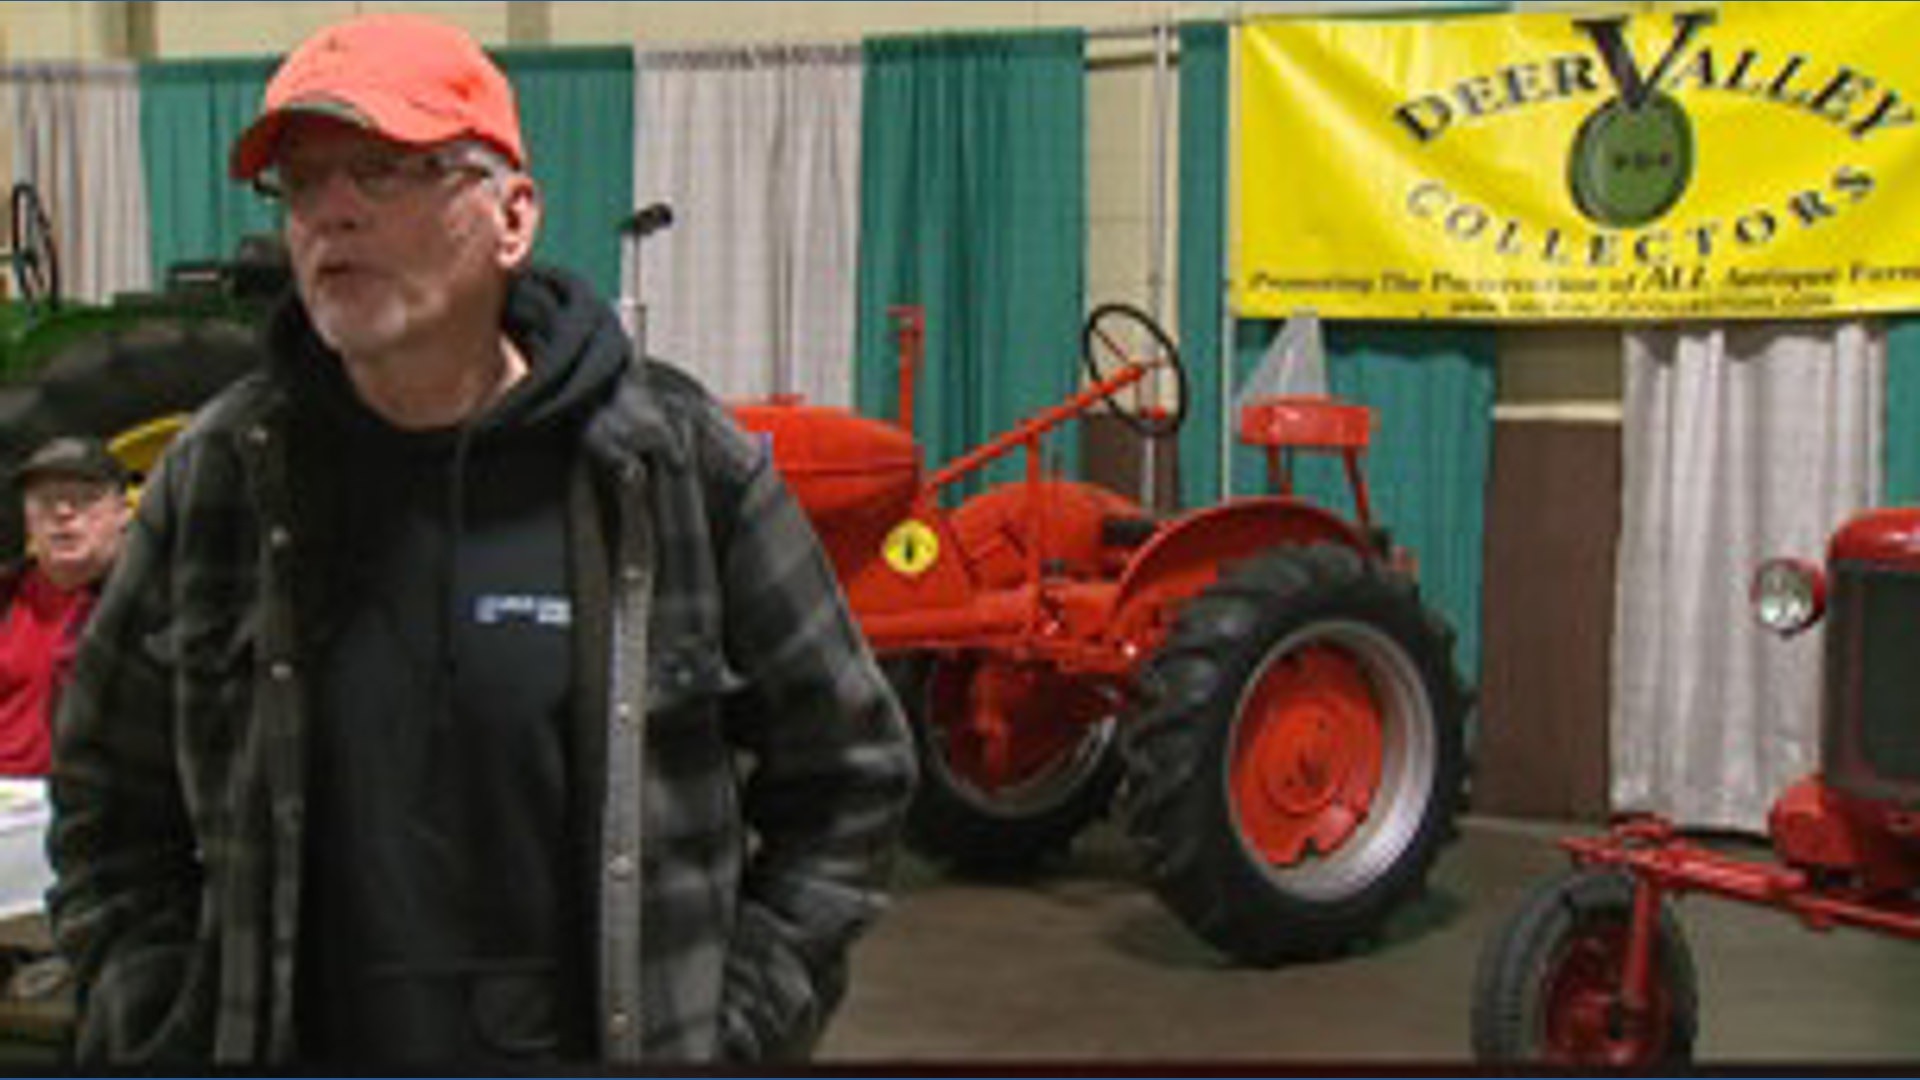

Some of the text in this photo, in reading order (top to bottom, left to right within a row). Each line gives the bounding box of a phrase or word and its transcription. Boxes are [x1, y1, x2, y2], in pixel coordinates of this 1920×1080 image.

[1394, 9, 1917, 143] DEER VALLEY
[1408, 169, 1875, 267] COLLECTORS
[1638, 263, 1706, 292] ALL
